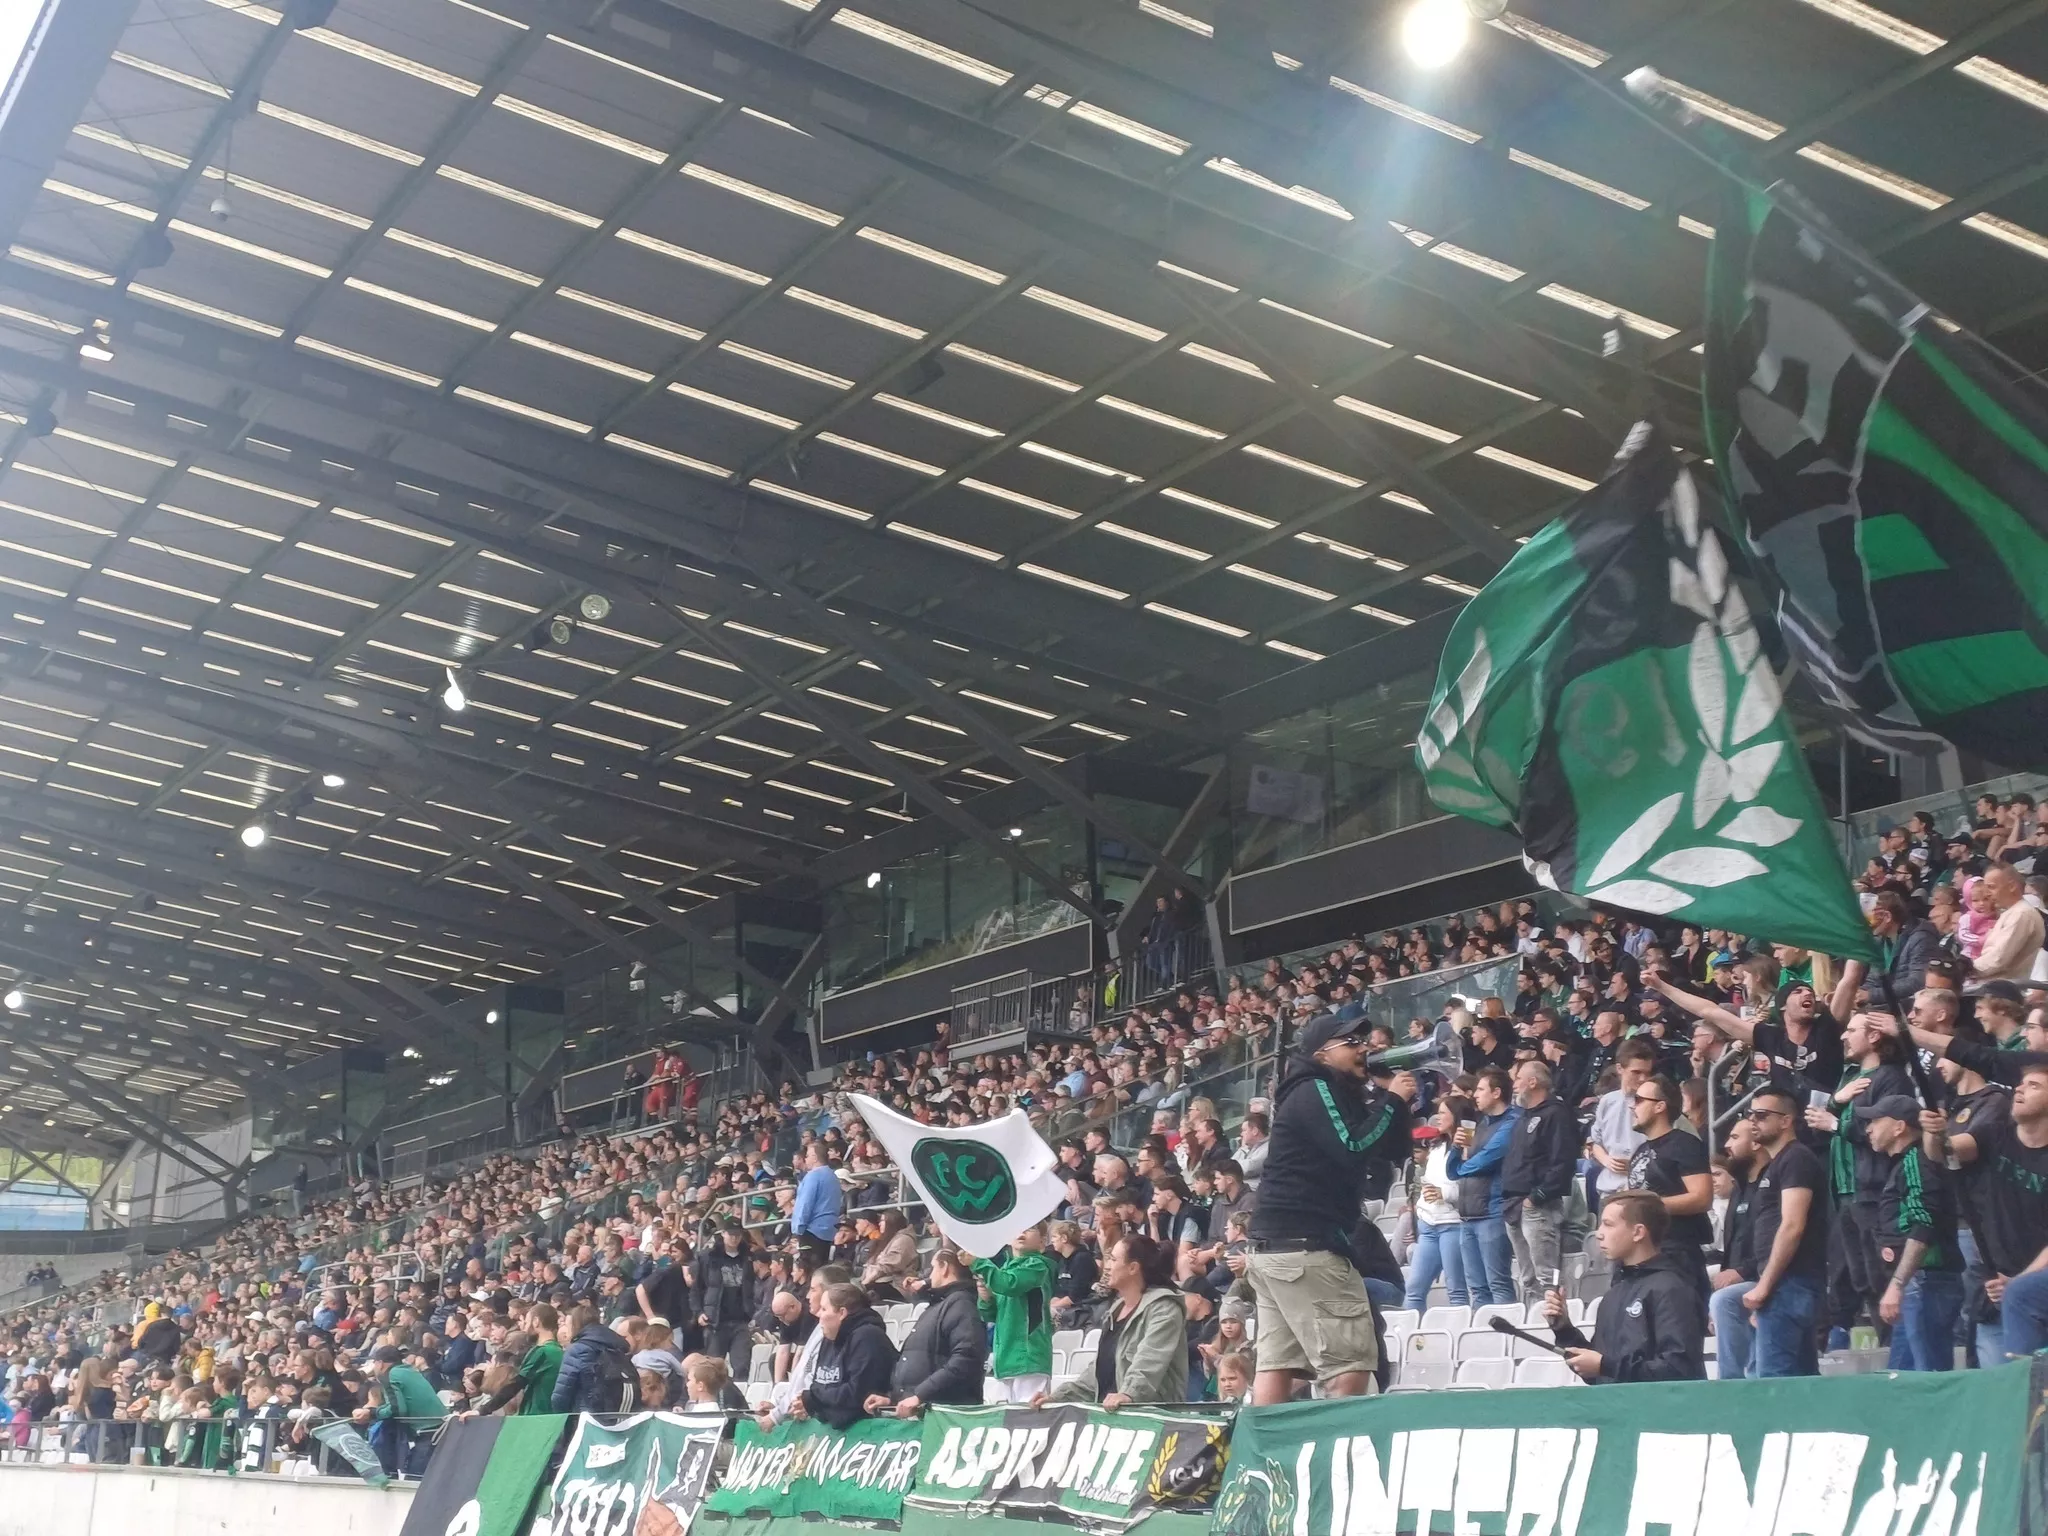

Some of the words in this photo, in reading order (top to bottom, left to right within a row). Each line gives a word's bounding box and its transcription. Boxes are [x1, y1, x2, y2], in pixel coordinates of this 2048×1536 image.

[930, 1151, 988, 1190] FC
[805, 1432, 922, 1494] INVENTAR
[924, 1421, 1156, 1495] ASPIRANTE
